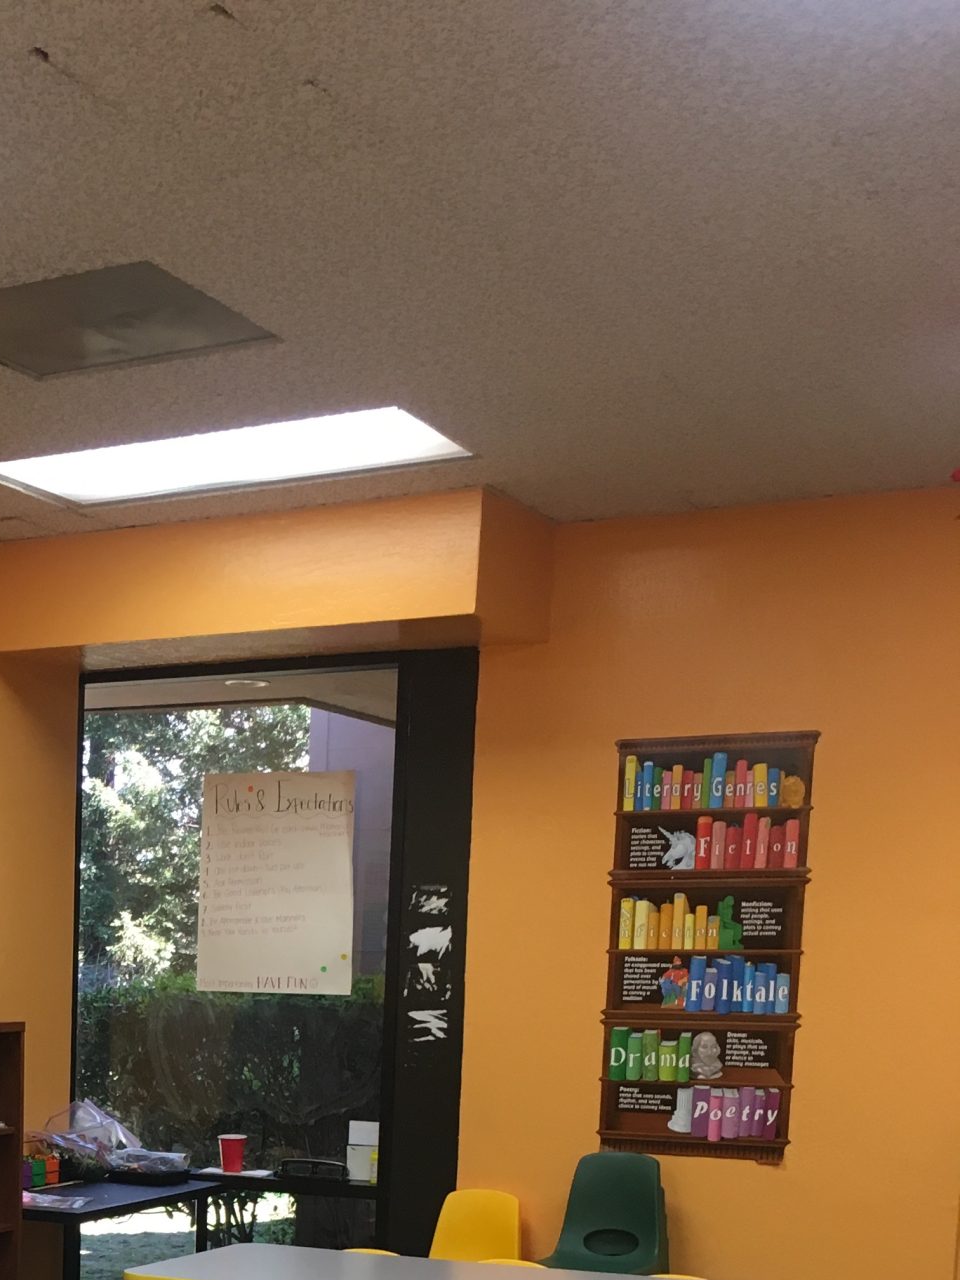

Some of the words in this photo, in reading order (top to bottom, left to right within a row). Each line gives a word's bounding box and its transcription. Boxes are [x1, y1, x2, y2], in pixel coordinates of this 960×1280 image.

[625, 778, 702, 801] Literary
[712, 777, 777, 796] Genres
[698, 836, 797, 858] Fiction
[690, 979, 789, 1002] Folktale
[609, 1046, 690, 1068] Drama
[694, 1101, 778, 1125] Poetry
